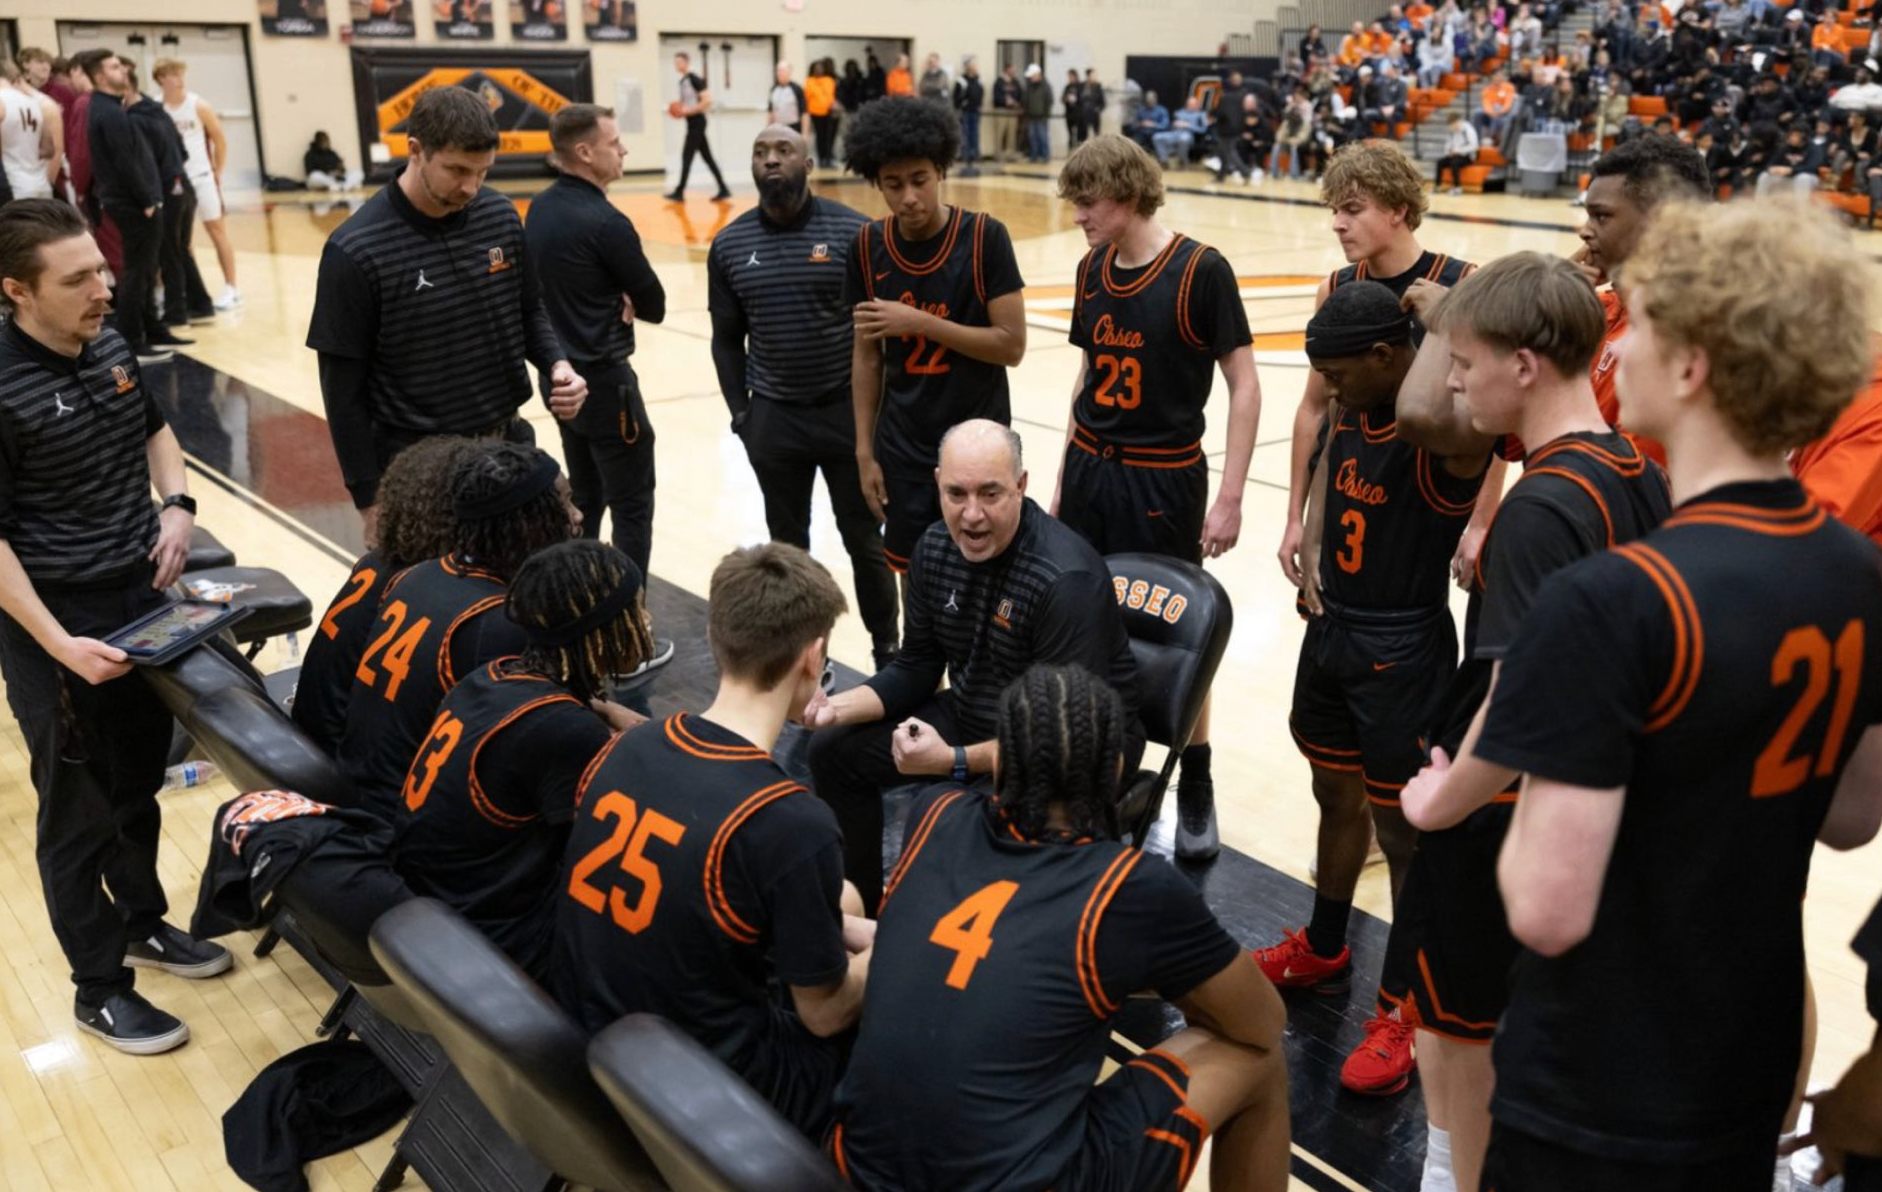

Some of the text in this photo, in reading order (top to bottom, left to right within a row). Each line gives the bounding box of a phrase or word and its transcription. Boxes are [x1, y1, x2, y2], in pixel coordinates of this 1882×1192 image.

[20, 107, 37, 132] 14
[902, 332, 951, 375] 22
[1093, 314, 1145, 349] Osseo
[1095, 354, 1142, 410] 23
[1335, 457, 1389, 506] Osseo
[1336, 508, 1366, 574] 3
[1112, 575, 1188, 625] SSEO
[355, 599, 432, 702] 24
[1749, 618, 1865, 799] 21
[568, 790, 687, 935] 25
[929, 878, 1020, 991] 4
